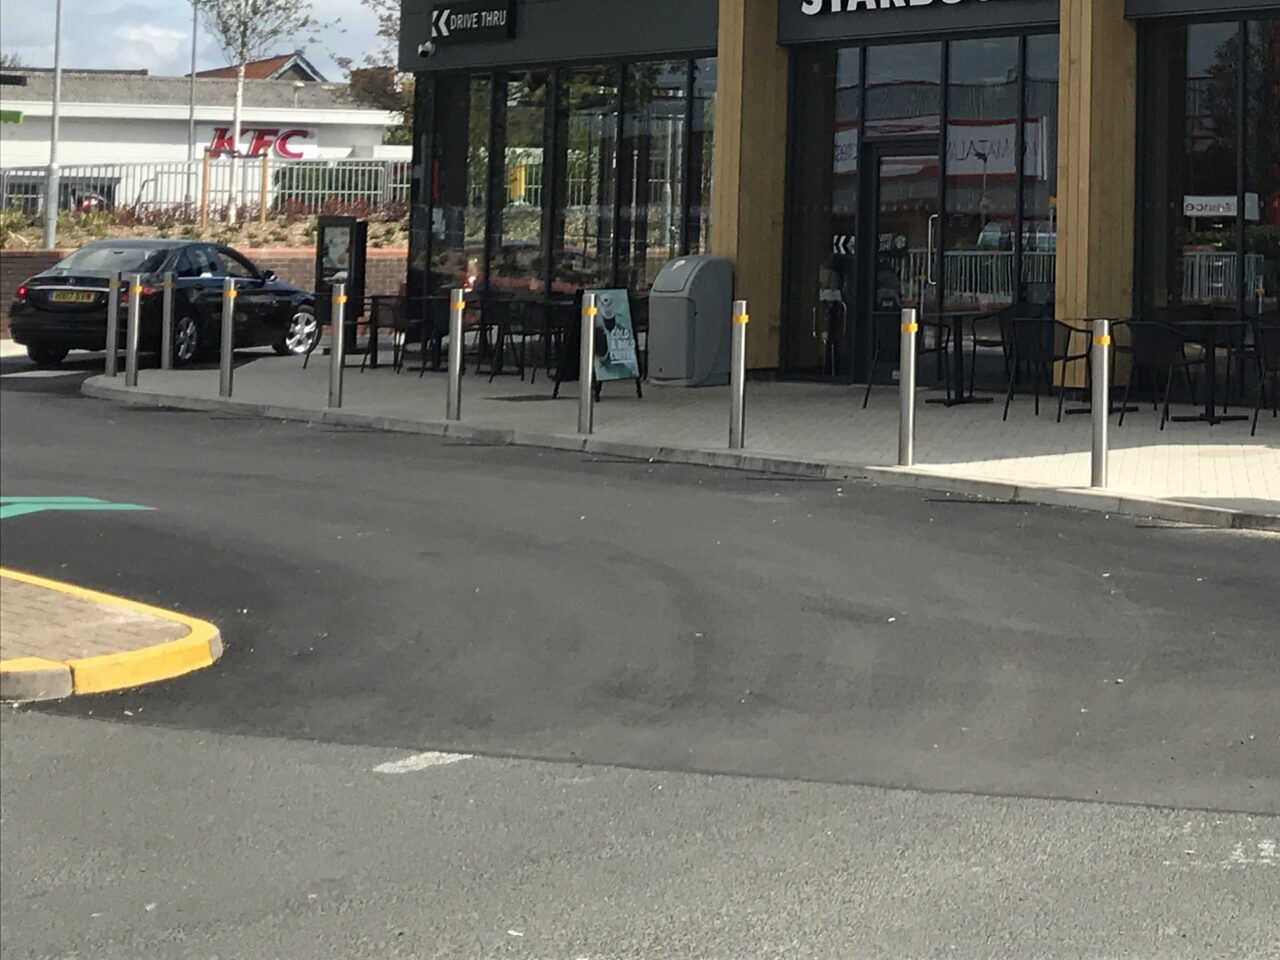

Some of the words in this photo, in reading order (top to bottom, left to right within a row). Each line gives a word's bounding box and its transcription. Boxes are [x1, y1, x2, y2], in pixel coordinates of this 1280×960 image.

[450, 12, 478, 30] DRIVE
[481, 10, 506, 26] THRU
[210, 128, 309, 158] KFC
